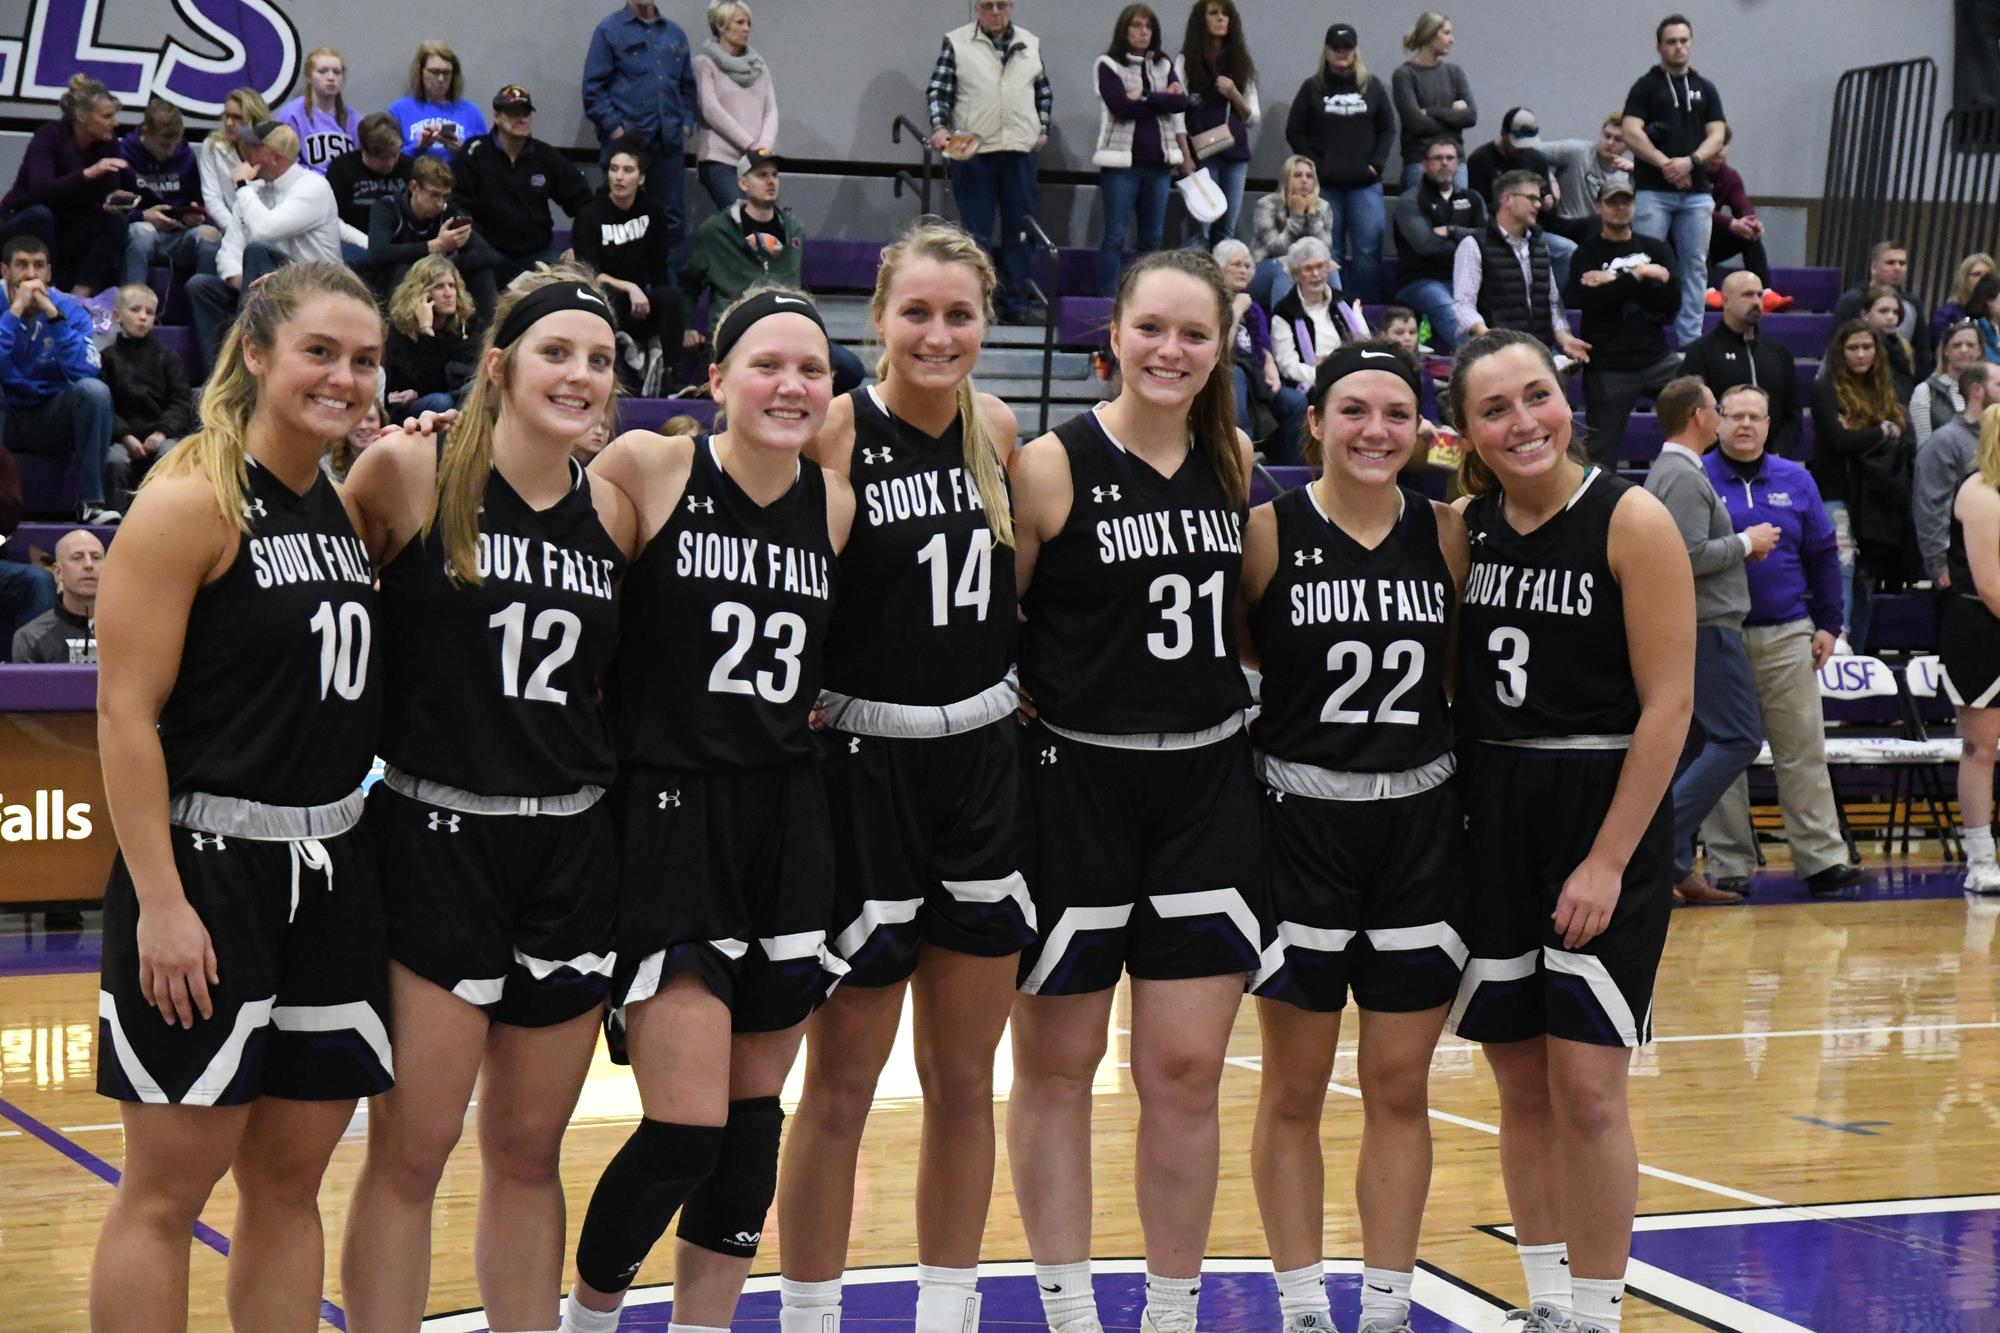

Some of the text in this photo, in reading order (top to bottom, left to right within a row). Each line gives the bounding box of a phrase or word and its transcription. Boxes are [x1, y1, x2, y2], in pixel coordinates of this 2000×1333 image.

[0, 0, 301, 119] LS
[601, 214, 650, 246] PUMA
[865, 470, 946, 526] SIOUX
[249, 533, 325, 589] SIOUX
[444, 532, 614, 600] OUX FALLS
[676, 530, 829, 600] SIOUX FALLS
[1096, 509, 1242, 564] SIOUX FALLS
[917, 528, 992, 627] 14
[1291, 579, 1444, 626] SIOUX FALLS
[1463, 562, 1594, 617] IOUX FALLS
[1147, 570, 1227, 660] 31
[310, 601, 371, 701] 10
[488, 601, 582, 705] 12
[708, 601, 807, 704] 23
[1320, 639, 1425, 725] 22
[1488, 626, 1530, 708] 3
[1820, 661, 1875, 692] USF
[0, 789, 93, 842] alls
